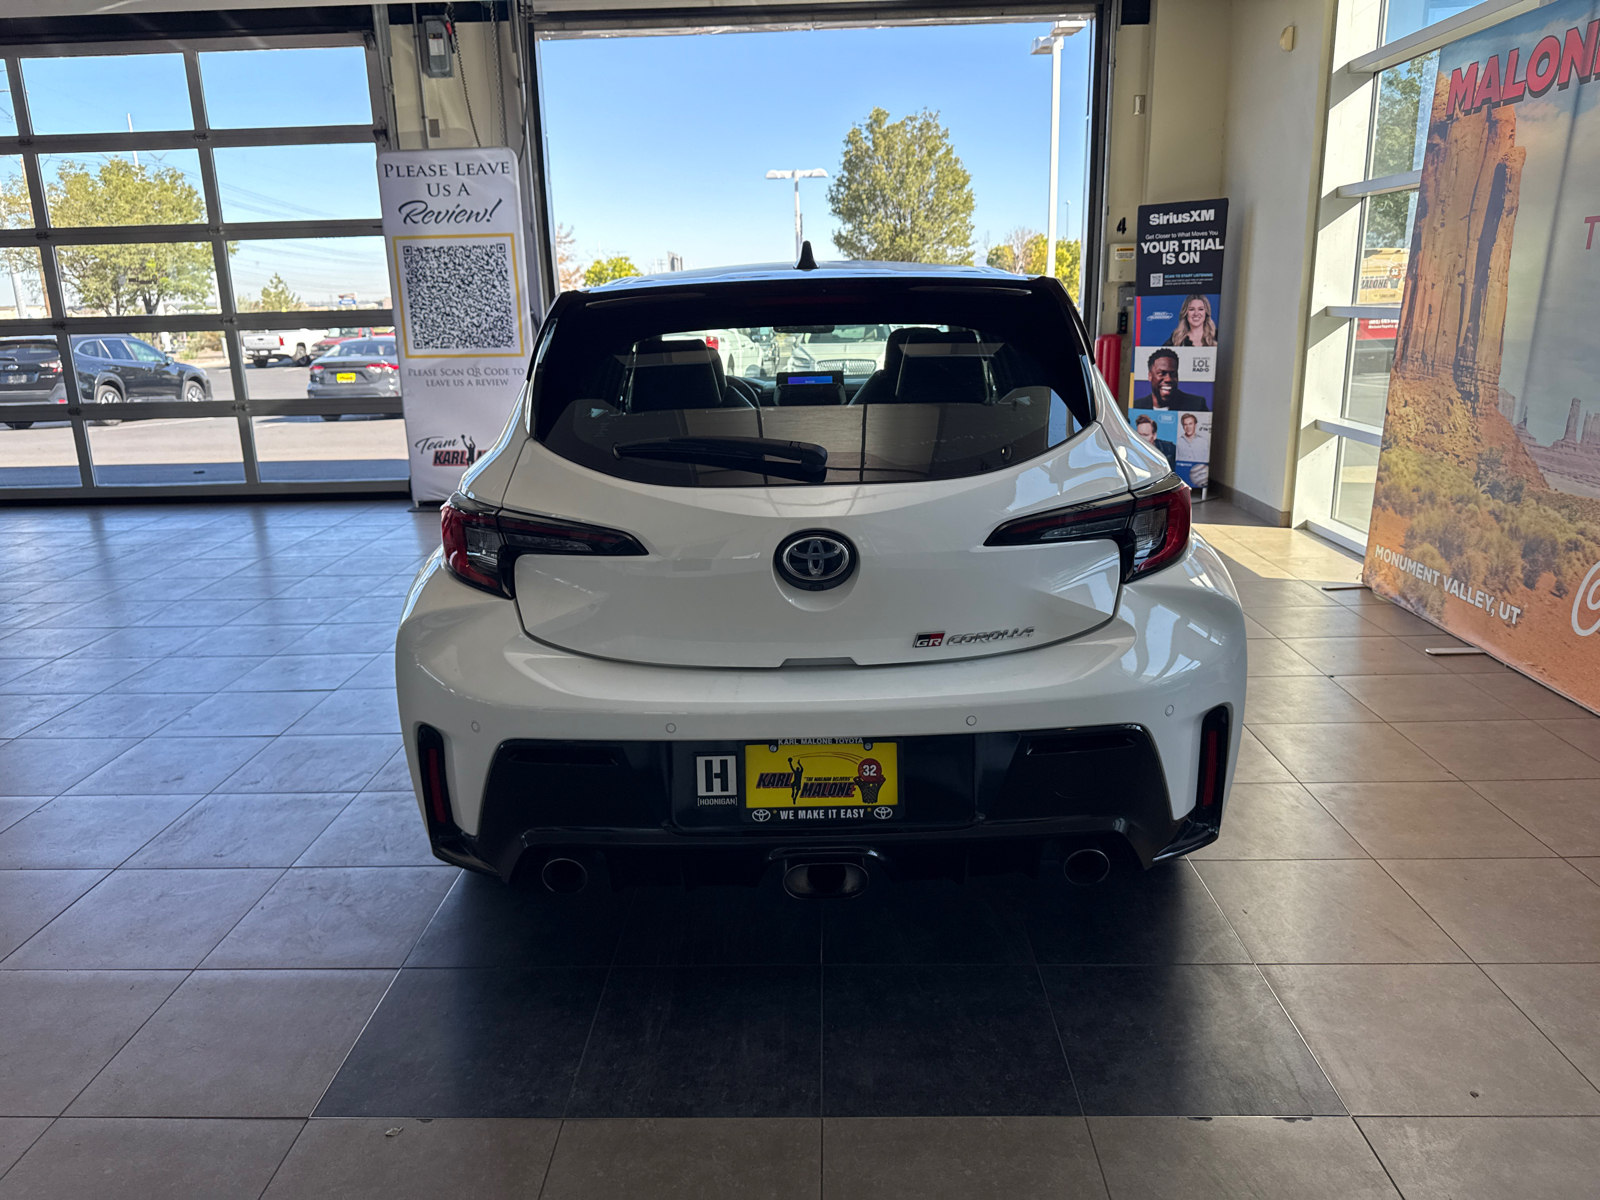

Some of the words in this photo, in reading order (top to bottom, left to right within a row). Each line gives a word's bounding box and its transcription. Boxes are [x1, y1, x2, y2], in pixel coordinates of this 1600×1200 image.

[383, 163, 448, 178] PLEASE
[455, 161, 510, 176] LEAVE
[426, 182, 451, 197] US
[457, 182, 472, 196] A
[398, 198, 503, 225] Review!
[1149, 208, 1215, 226] SiriusXM
[1116, 217, 1127, 235] 4
[1155, 232, 1171, 240] Closer
[1140, 240, 1179, 254] YOUR
[1181, 237, 1225, 251] TRIAL
[1162, 252, 1176, 265] IS
[1178, 251, 1200, 264] ON
[1193, 359, 1209, 367] LOL
[407, 368, 438, 377] PLEASE
[440, 367, 464, 376] SCAN
[466, 367, 481, 378] QR
[484, 367, 510, 376] CODE
[512, 367, 525, 376] TO
[426, 379, 451, 387] LEAVE
[453, 379, 464, 387] US
[467, 379, 474, 387] A
[475, 379, 509, 387] REVIEW
[414, 436, 459, 455] Team
[433, 450, 467, 466] KARL
[1374, 544, 1441, 586] MONUMENT
[1443, 574, 1496, 618] VALLEY,
[1499, 601, 1522, 625] UT
[947, 626, 1035, 646] COROLLA
[862, 764, 877, 776] 32
[756, 773, 793, 789] KARL
[800, 782, 856, 798] MALONE
[780, 810, 794, 820] WE
[798, 809, 825, 819] MAKE
[828, 809, 837, 819] IT
[840, 808, 865, 818] EASY
